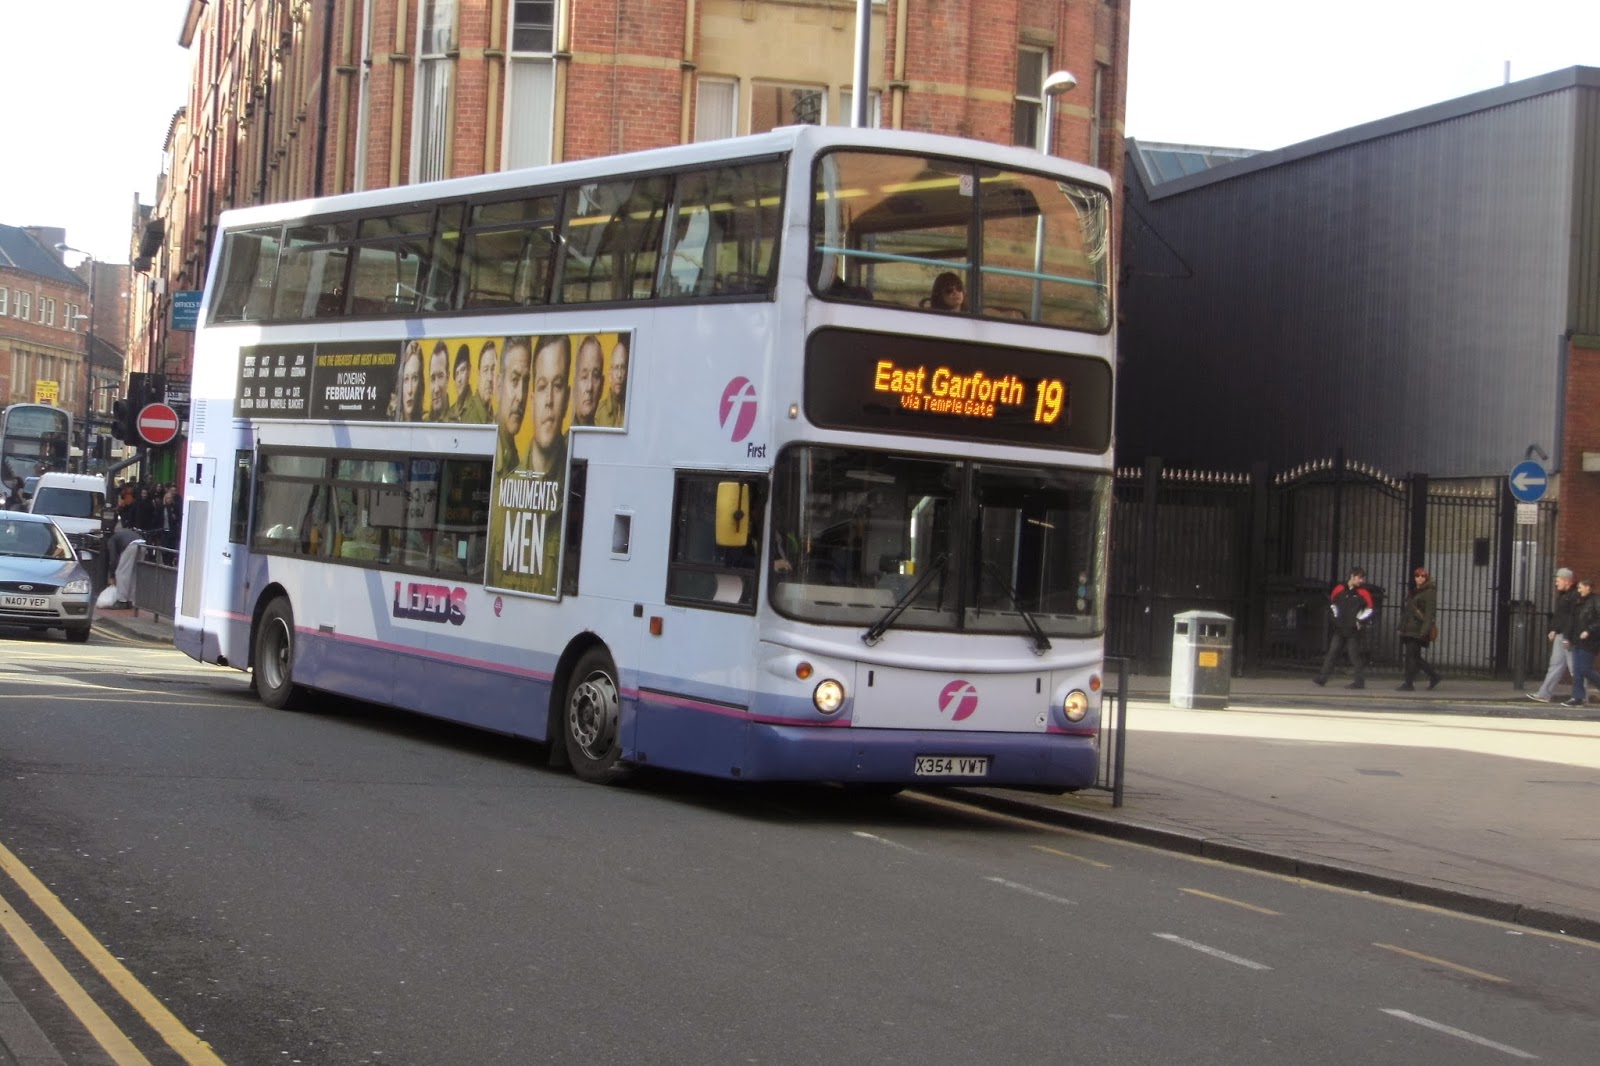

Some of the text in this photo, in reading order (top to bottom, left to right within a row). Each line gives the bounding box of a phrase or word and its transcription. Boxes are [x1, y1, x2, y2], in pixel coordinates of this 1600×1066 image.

[343, 372, 366, 385] CINEMAS
[37, 391, 45, 399] TO
[325, 386, 377, 401] FEBRUARY 14
[874, 360, 1064, 423] East Garforth 19
[923, 396, 962, 415] Temple
[964, 401, 994, 418] Gate
[746, 442, 766, 458] First
[498, 478, 559, 512] MONUMENTS
[502, 511, 547, 576] MEN
[5, 597, 46, 607] NA07 VEP
[915, 758, 987, 774] X354 VWT
